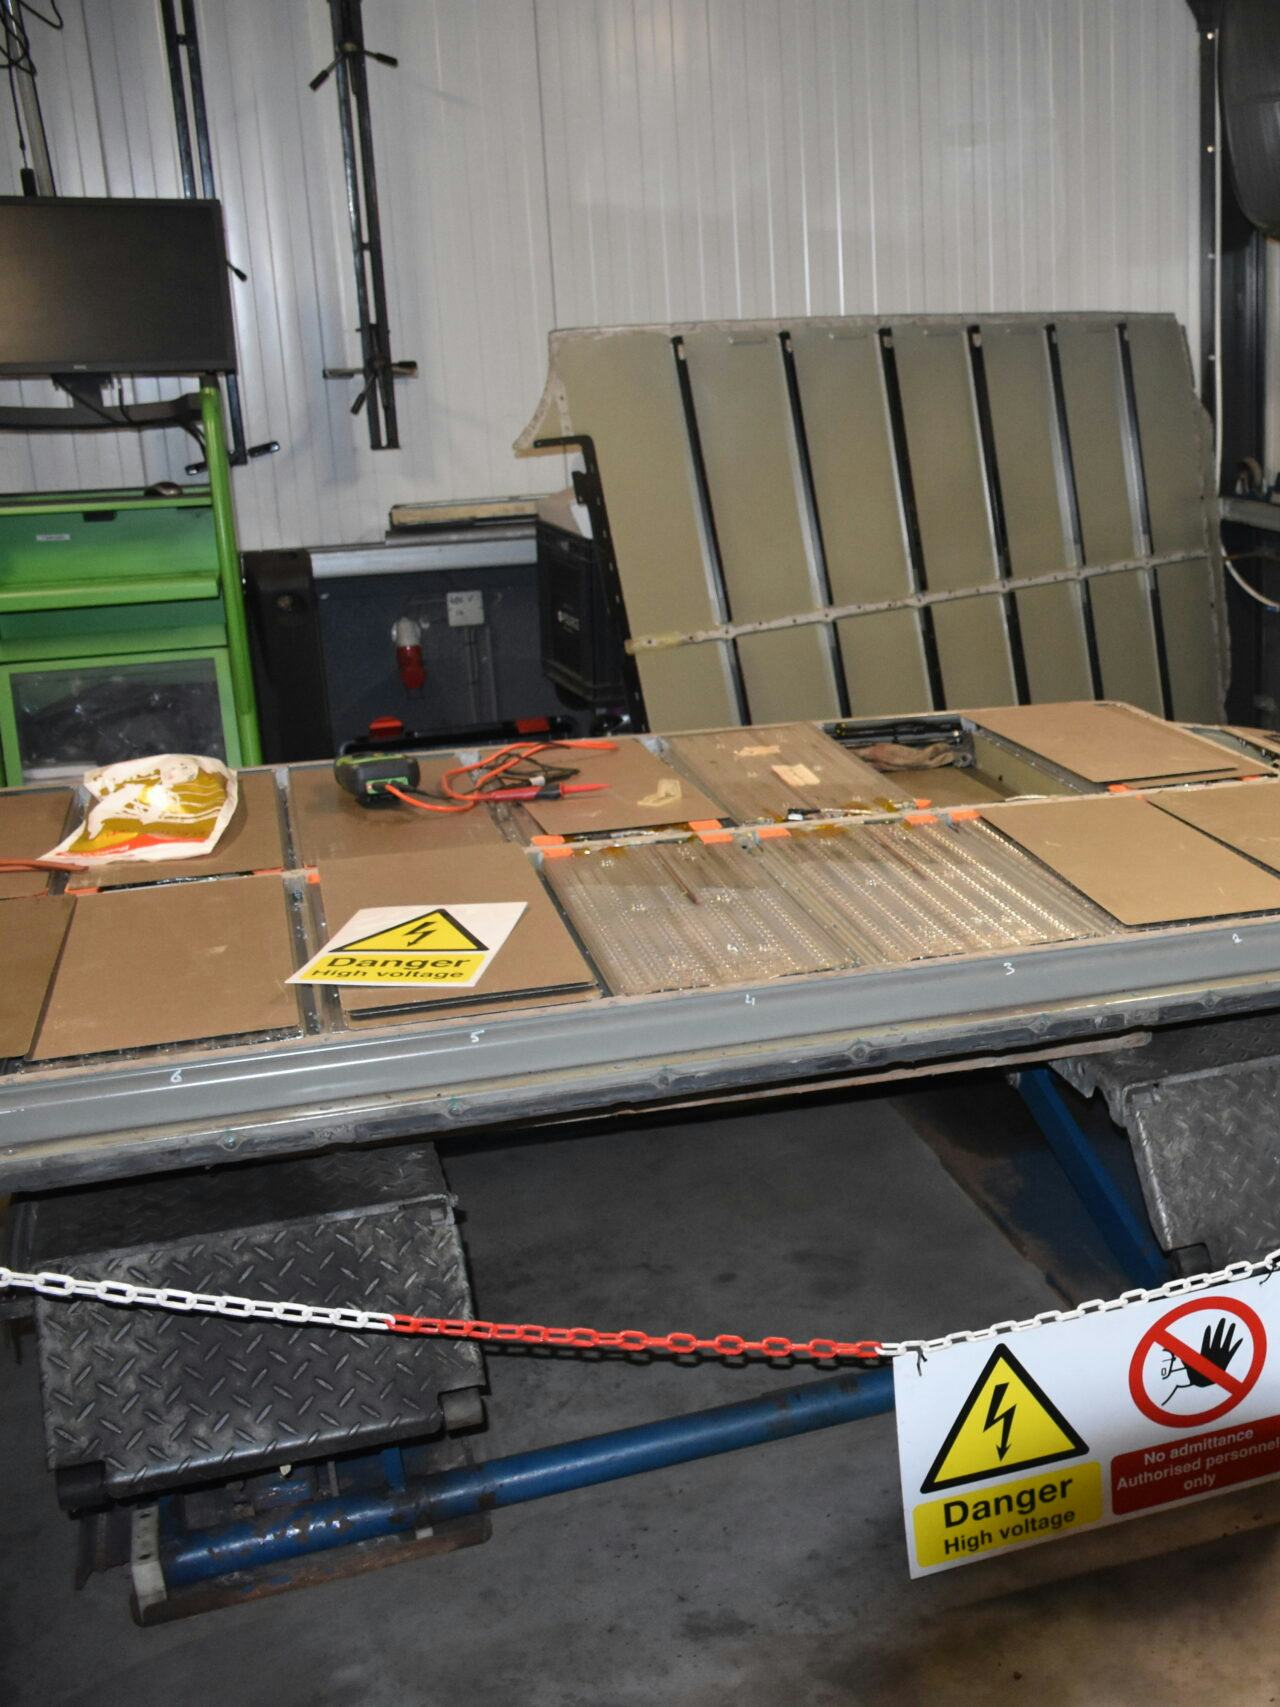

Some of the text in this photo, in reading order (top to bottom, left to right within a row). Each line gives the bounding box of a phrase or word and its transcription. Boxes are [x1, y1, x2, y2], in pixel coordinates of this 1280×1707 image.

[327, 957, 472, 971] Danger
[1003, 962, 1015, 975] 3
[311, 969, 464, 979] High voltage
[745, 994, 755, 1006] 4
[470, 1029, 484, 1043] 5
[170, 1070, 182, 1084] 6
[1144, 1428, 1254, 1467] No admittance
[1116, 1436, 1280, 1491] Authorised personnel
[1183, 1472, 1216, 1491] only
[943, 1478, 1073, 1528] Danger
[944, 1509, 1075, 1555] High voltage
